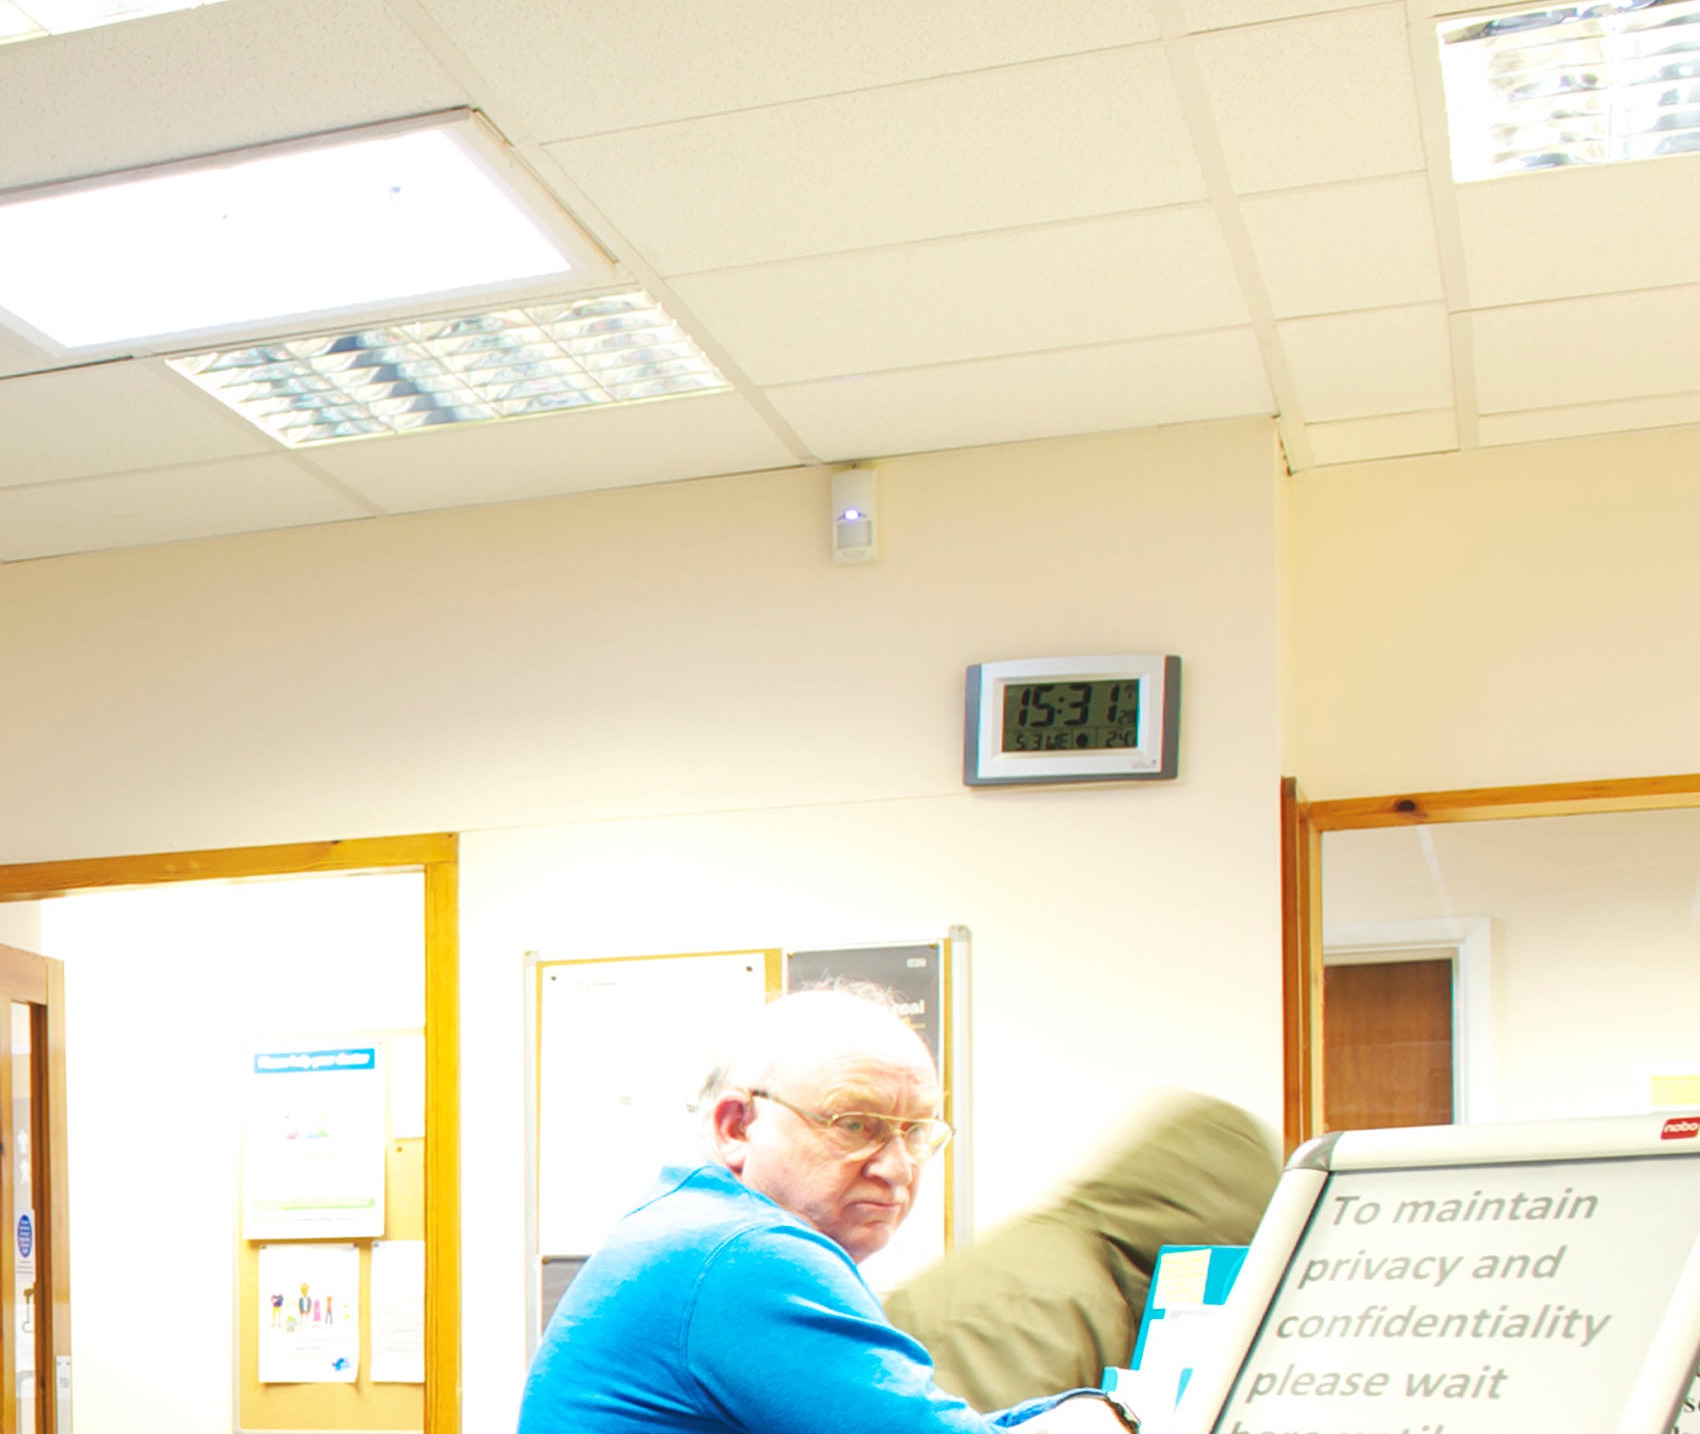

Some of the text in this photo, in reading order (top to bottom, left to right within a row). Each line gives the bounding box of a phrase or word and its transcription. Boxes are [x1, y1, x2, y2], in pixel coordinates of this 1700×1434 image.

[1018, 684, 1120, 727] 15:31
[1664, 1121, 1698, 1133] nobo
[1332, 1187, 1600, 1226] To maintain
[1297, 1245, 1568, 1290] privacy and
[1276, 1304, 1612, 1347] confidentiality
[1244, 1363, 1509, 1403] please wait
